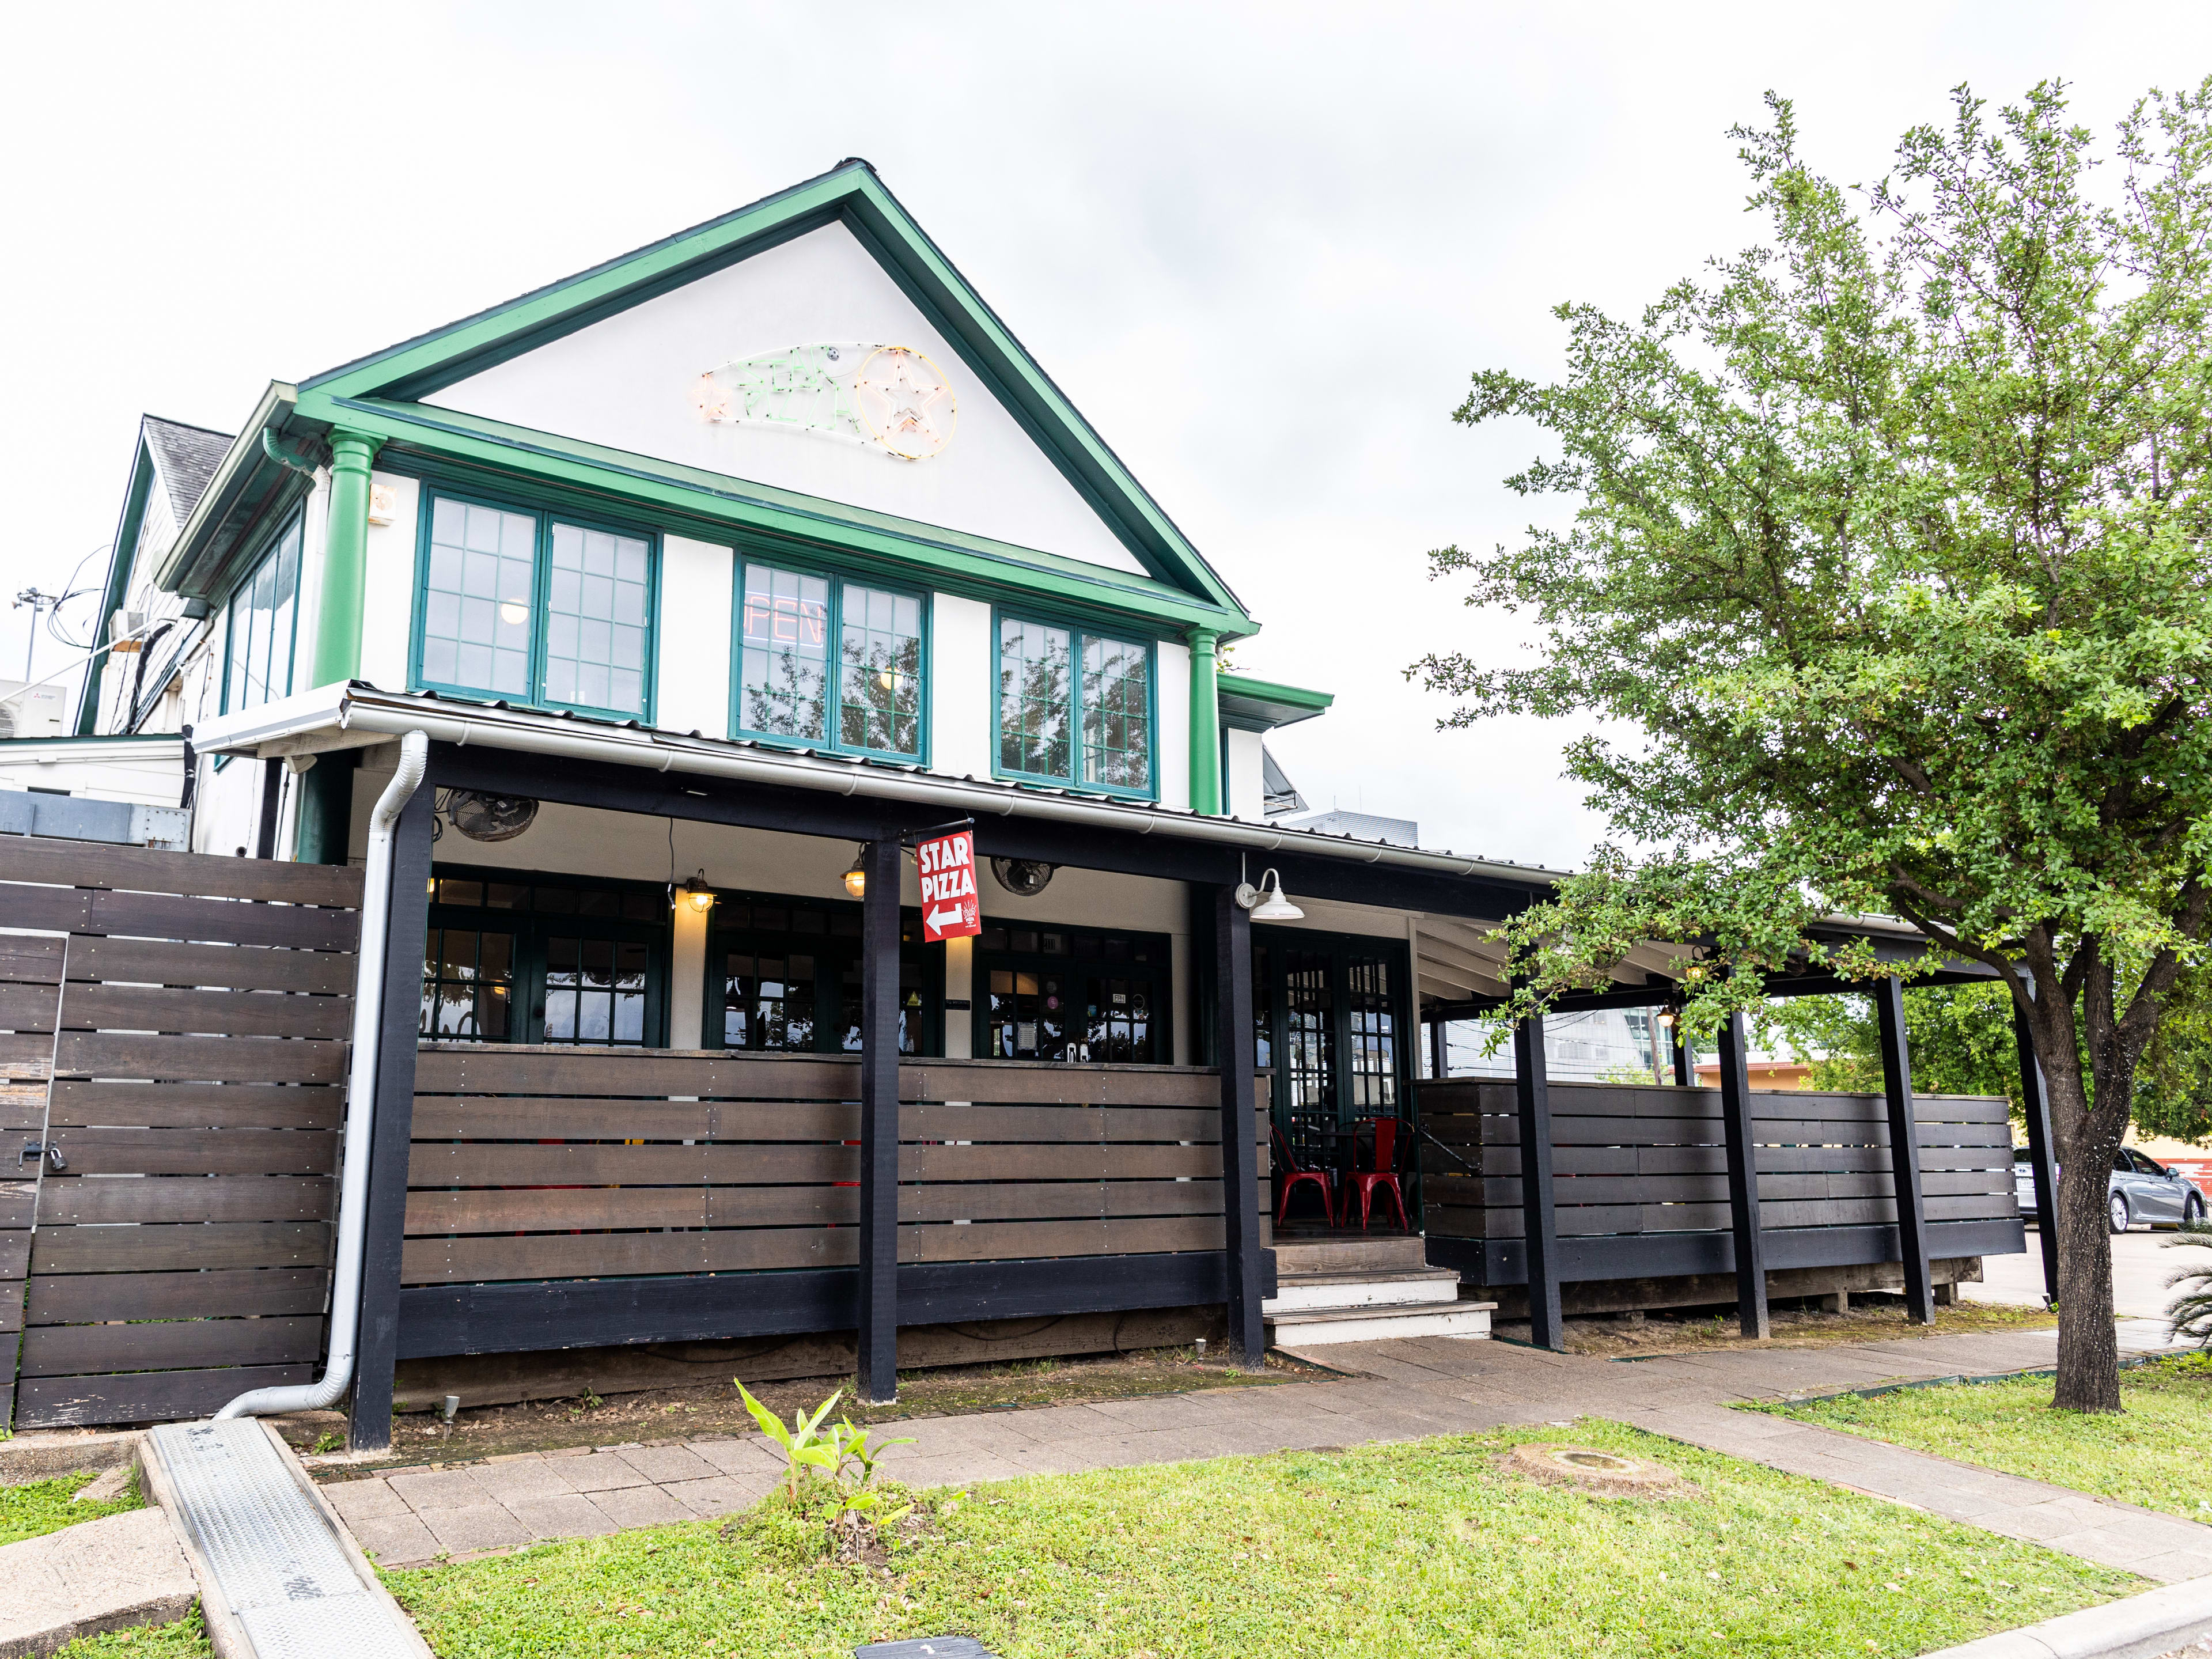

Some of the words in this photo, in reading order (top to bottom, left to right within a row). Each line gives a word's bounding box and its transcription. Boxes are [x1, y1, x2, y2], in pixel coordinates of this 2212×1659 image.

[737, 345, 836, 389] STAR
[744, 384, 861, 433] PIZZA
[743, 595, 821, 642] PEN
[919, 836, 970, 874] STAR
[921, 868, 976, 903] PIZZA
